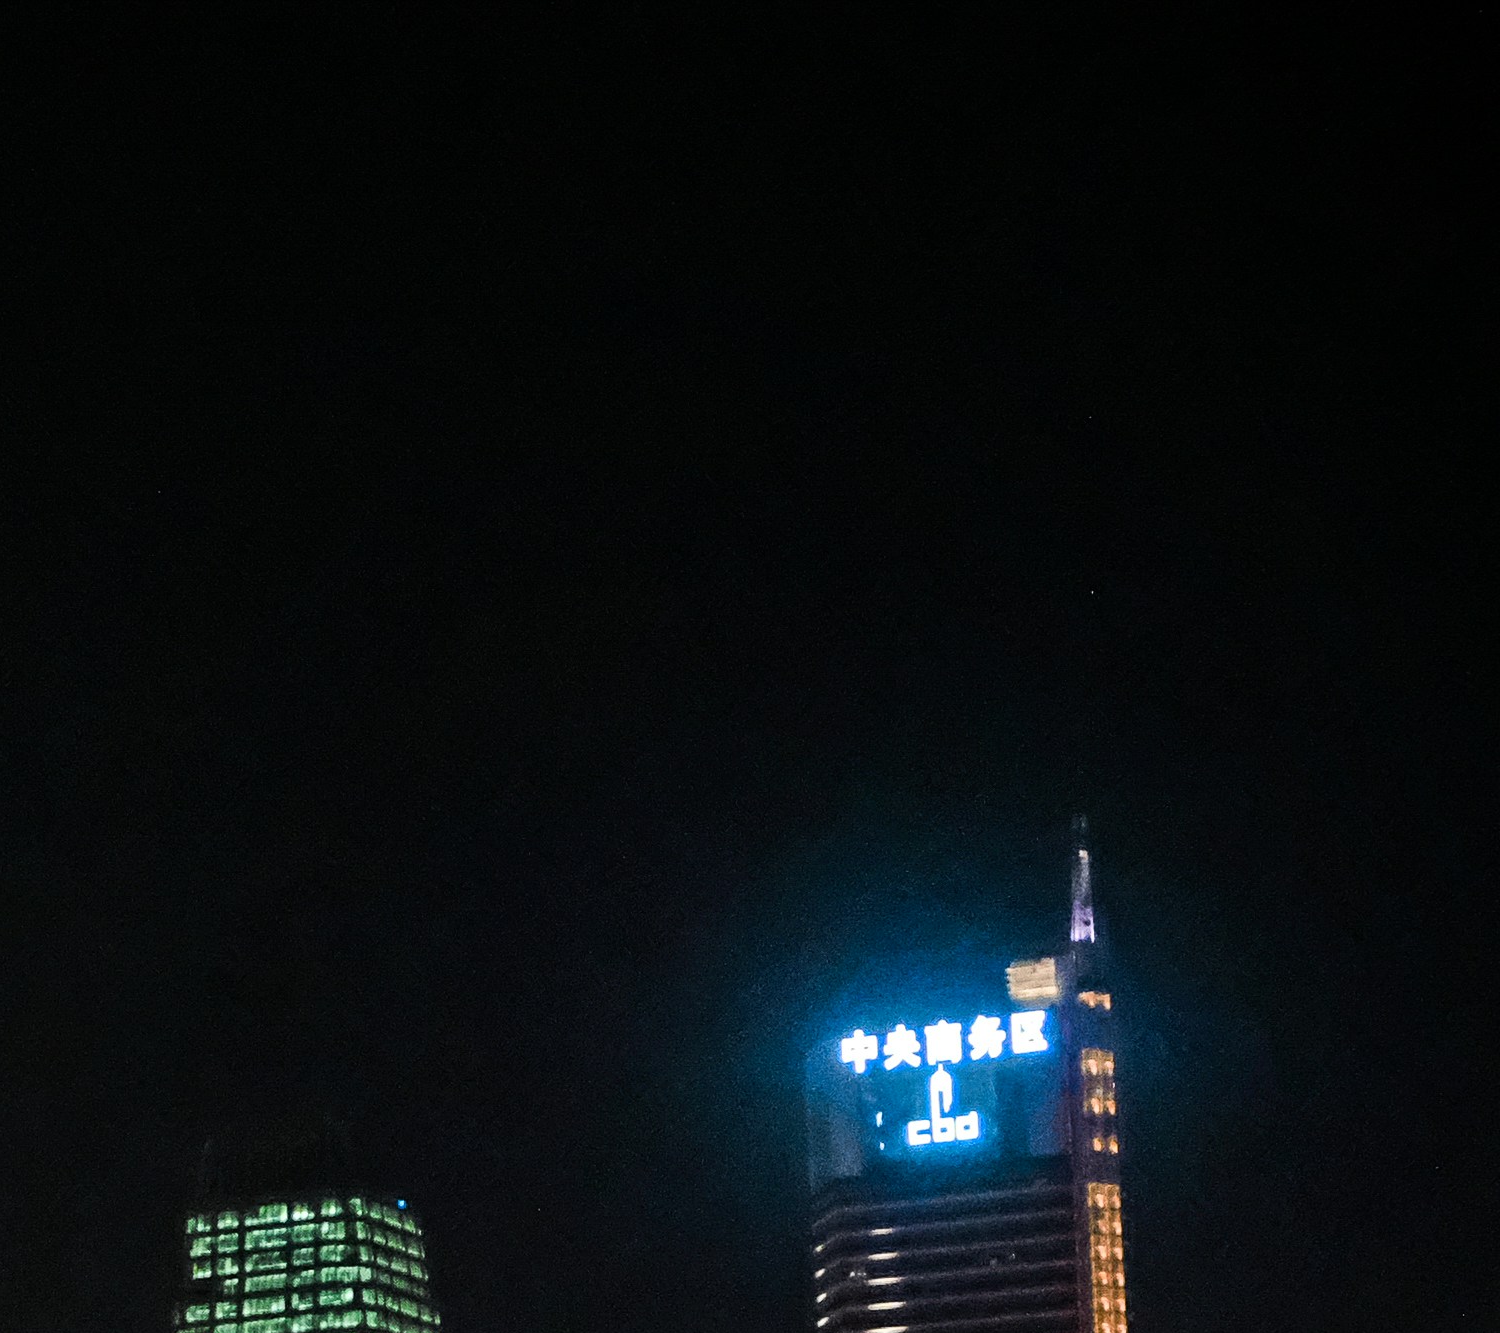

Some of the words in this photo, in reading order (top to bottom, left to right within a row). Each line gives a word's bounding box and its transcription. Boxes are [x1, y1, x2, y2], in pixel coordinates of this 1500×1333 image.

[841, 1010, 1048, 1074] 中央商务区
